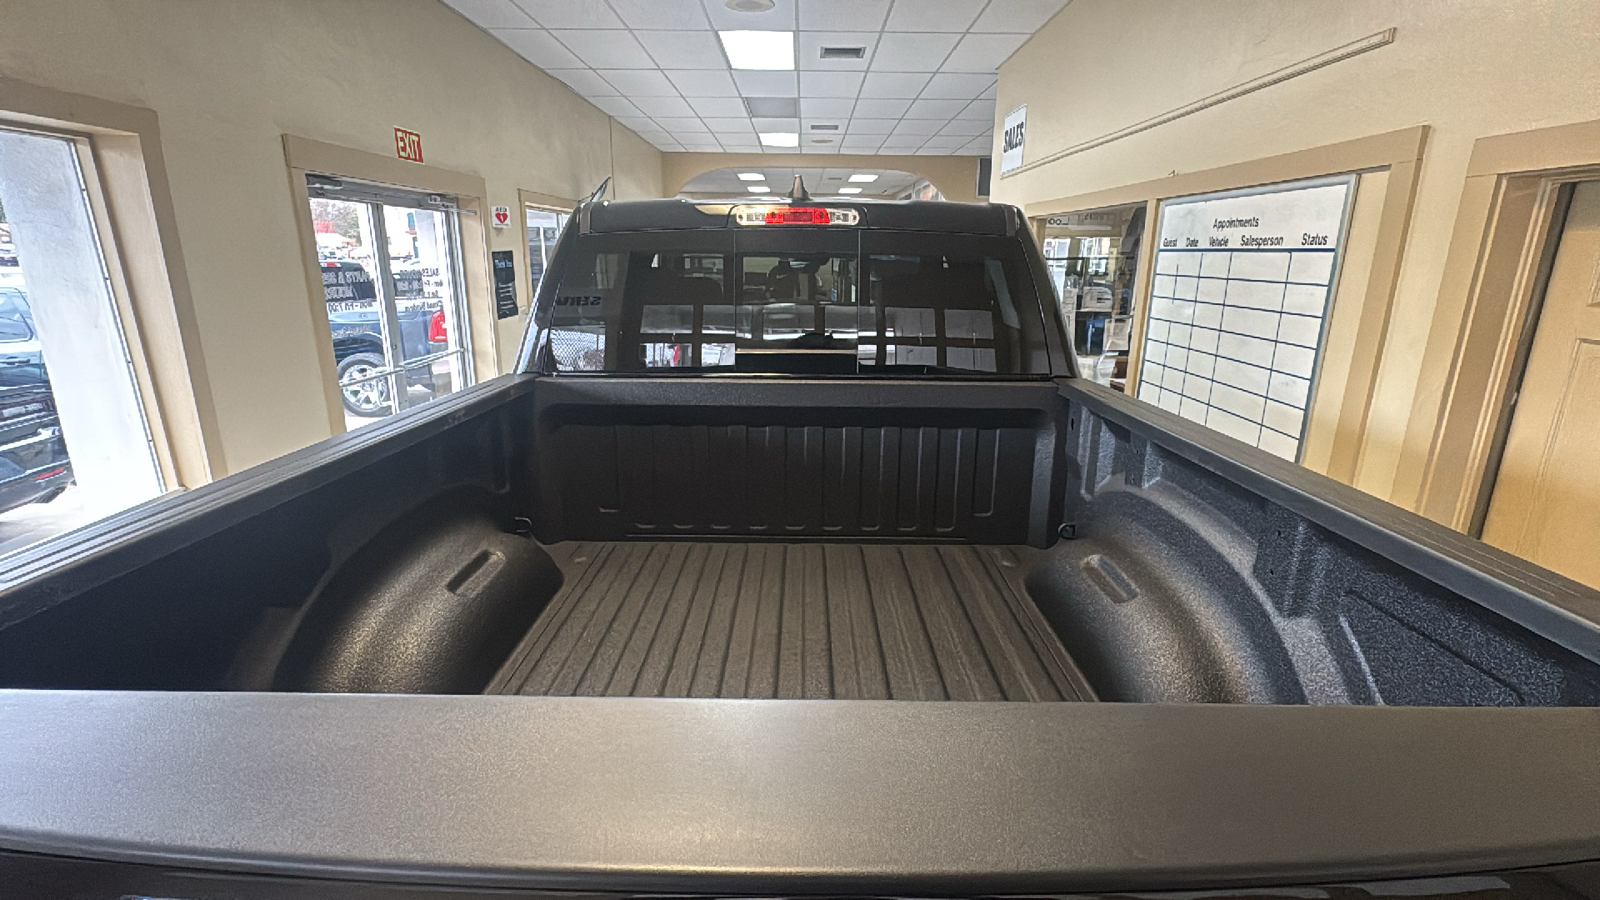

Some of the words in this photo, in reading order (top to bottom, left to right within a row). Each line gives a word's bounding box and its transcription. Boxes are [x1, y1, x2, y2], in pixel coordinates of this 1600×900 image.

[397, 131, 419, 160] EXIT
[1003, 121, 1024, 153] SALES
[1213, 217, 1259, 231] Appointments
[1163, 238, 1178, 247] Guest
[1186, 237, 1199, 247] Date
[1209, 236, 1229, 247] Vehicle
[1240, 235, 1284, 248] Salesperson
[1301, 233, 1328, 246] Status
